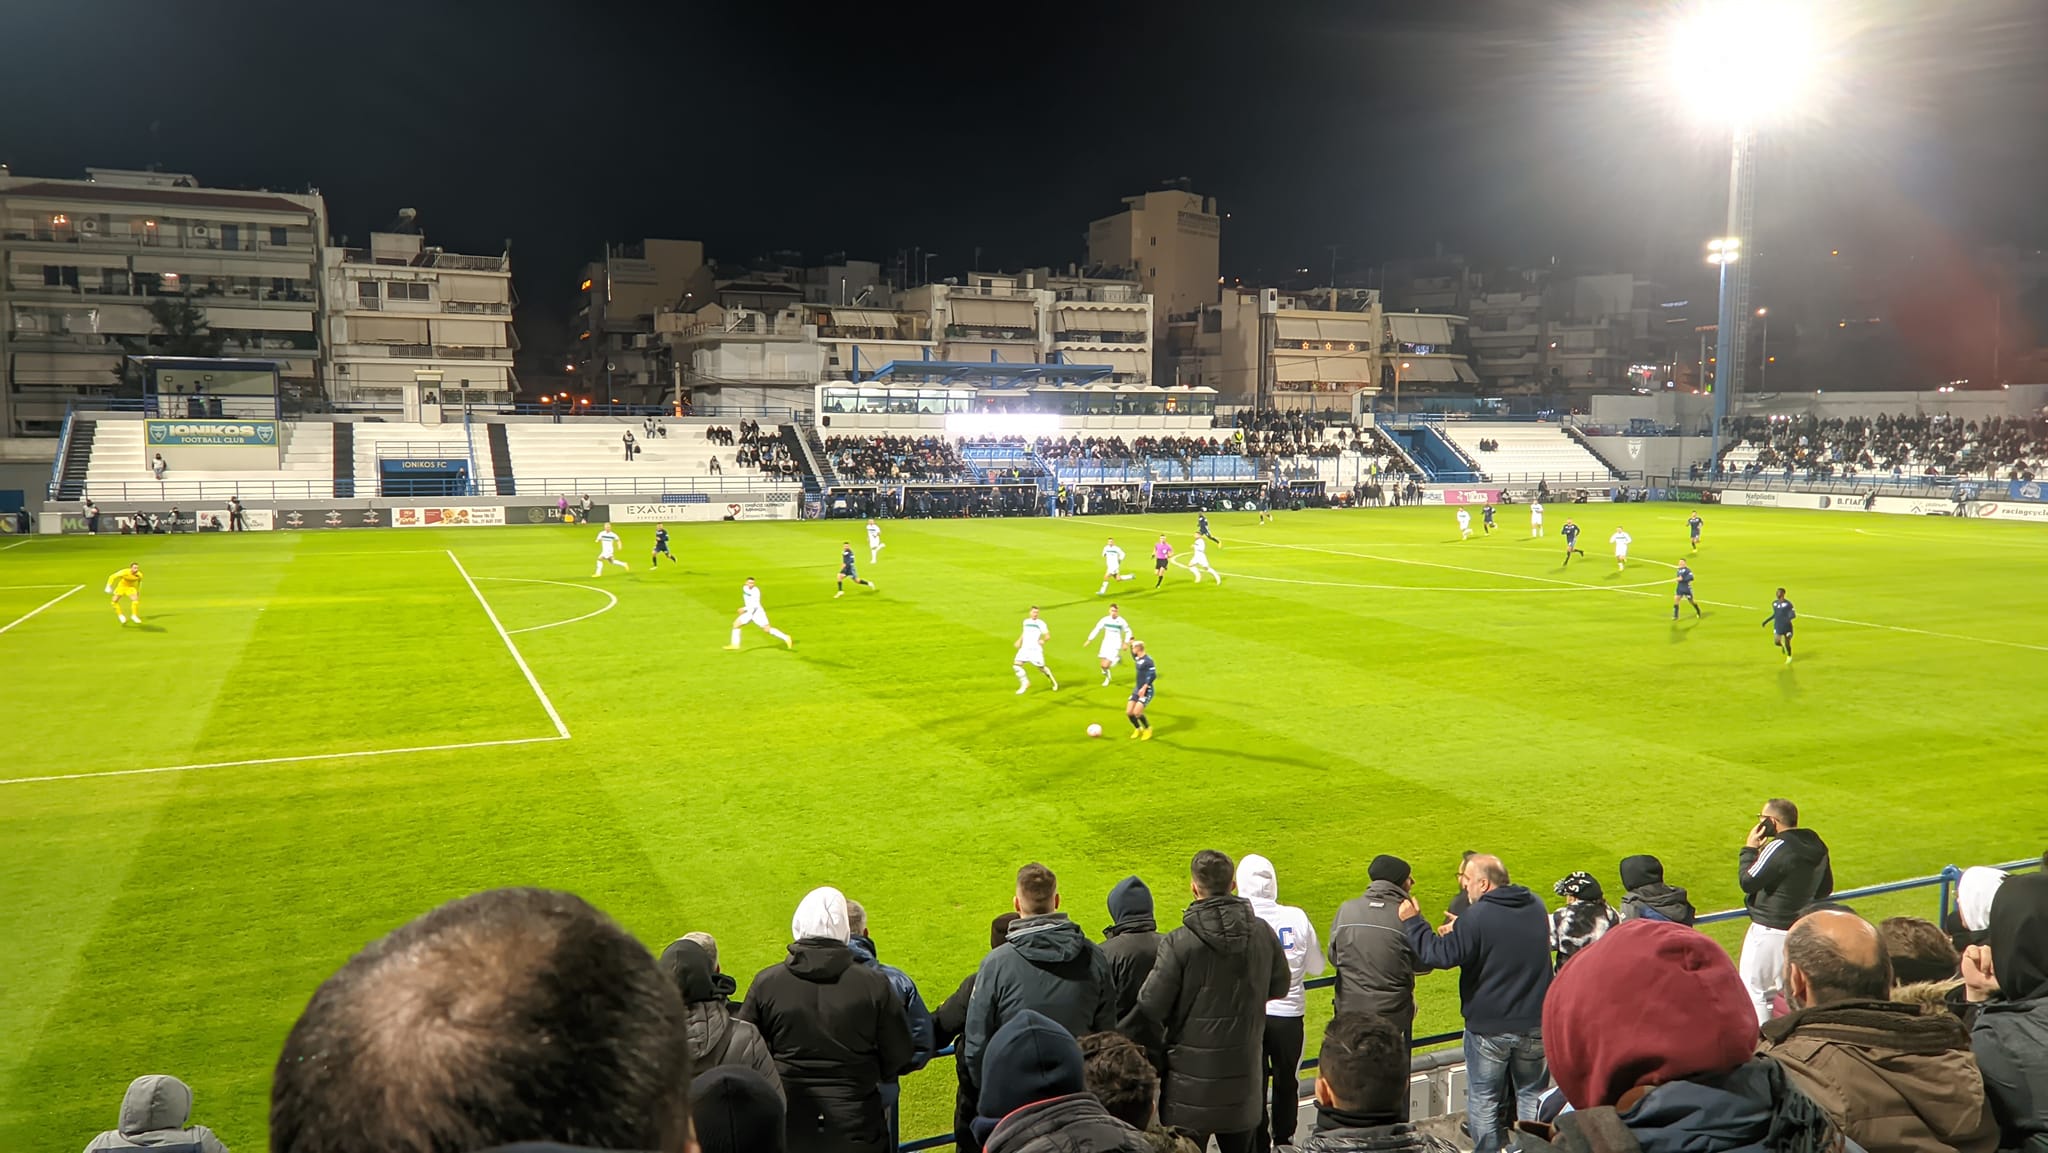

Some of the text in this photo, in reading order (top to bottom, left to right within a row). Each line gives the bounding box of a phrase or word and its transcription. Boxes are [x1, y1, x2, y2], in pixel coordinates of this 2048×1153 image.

[169, 425, 255, 437] IONIKOS
[181, 436, 245, 444] FOOTBALL CLUB
[402, 461, 448, 469] IONIKOS FC
[626, 504, 687, 515] EXACTT
